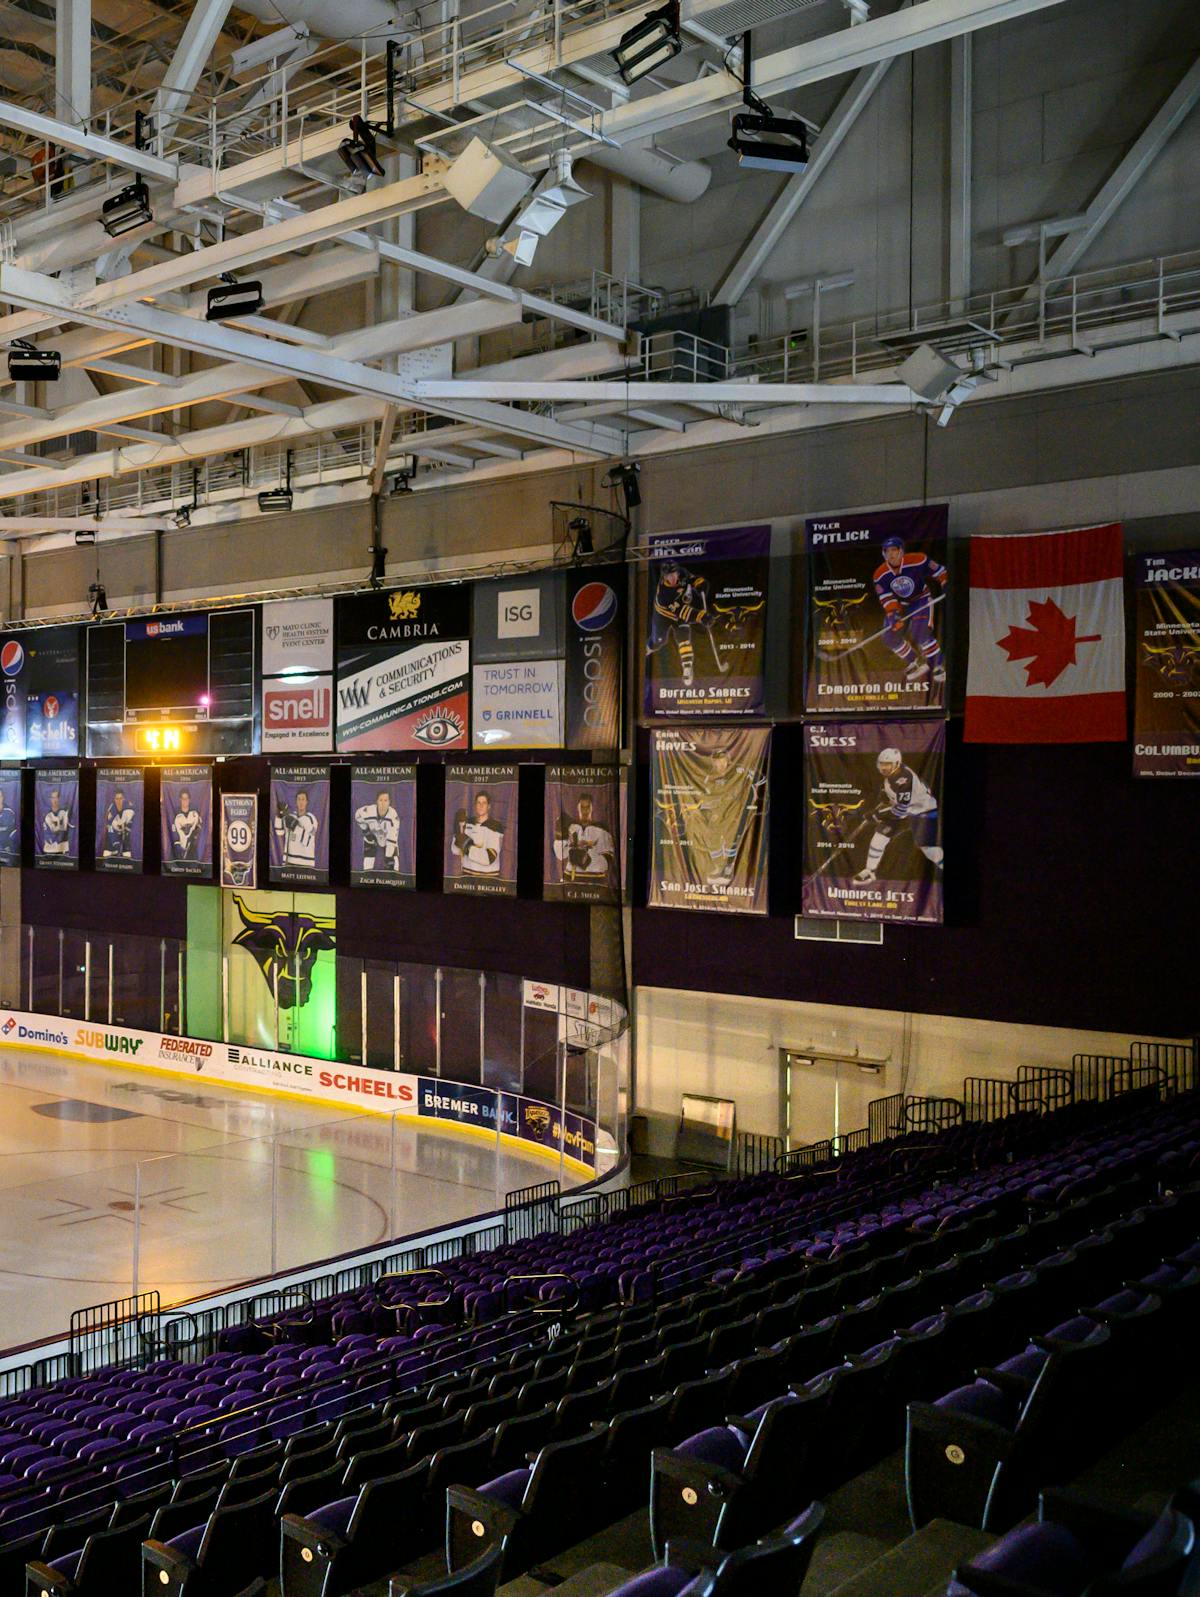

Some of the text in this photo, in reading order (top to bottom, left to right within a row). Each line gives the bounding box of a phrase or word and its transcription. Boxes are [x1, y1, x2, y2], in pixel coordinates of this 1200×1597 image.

[813, 530, 869, 545] PITLICK
[1144, 558, 1165, 567] TIM
[1144, 567, 1200, 582] JACK
[505, 605, 532, 622] ISG
[282, 628, 329, 638] HEALTH SYSTEM
[367, 623, 439, 640] CAMBRIA
[282, 638, 325, 648] EVENT CENTER
[376, 642, 462, 687] COMMUNICATIONS
[379, 690, 387, 699] &
[388, 664, 437, 697] SECURITY
[484, 667, 536, 681] TRUST IN
[484, 682, 553, 696] TOMORROW
[579, 636, 603, 728] pepsi
[818, 682, 930, 695] EDMONTON OILERS
[660, 687, 750, 698] BUFFALO SABRES
[269, 688, 325, 721] snell
[496, 709, 553, 721] GRINNELL
[810, 735, 857, 747] SUESS
[274, 767, 327, 775] ALL-AMERICAN
[355, 767, 412, 775] ALL-AMERICAN
[450, 767, 513, 775] ALL-AMERICAN
[898, 792, 911, 801] 73
[231, 827, 247, 845] 99
[477, 884, 506, 892] BRICKLEY
[661, 881, 755, 896] SAN JOSE SHARKS
[828, 887, 914, 902] WINNIPEG JETS
[18, 1026, 68, 1045] Domino's
[75, 1029, 143, 1055] SUBWAY
[160, 1037, 213, 1057] FEDERATED
[158, 1050, 196, 1065] INSURANCE
[242, 1055, 313, 1076] ALLIANCE
[319, 1071, 413, 1101] SCHEELS
[424, 1094, 479, 1115] BREMER
[482, 1104, 514, 1125] BANK
